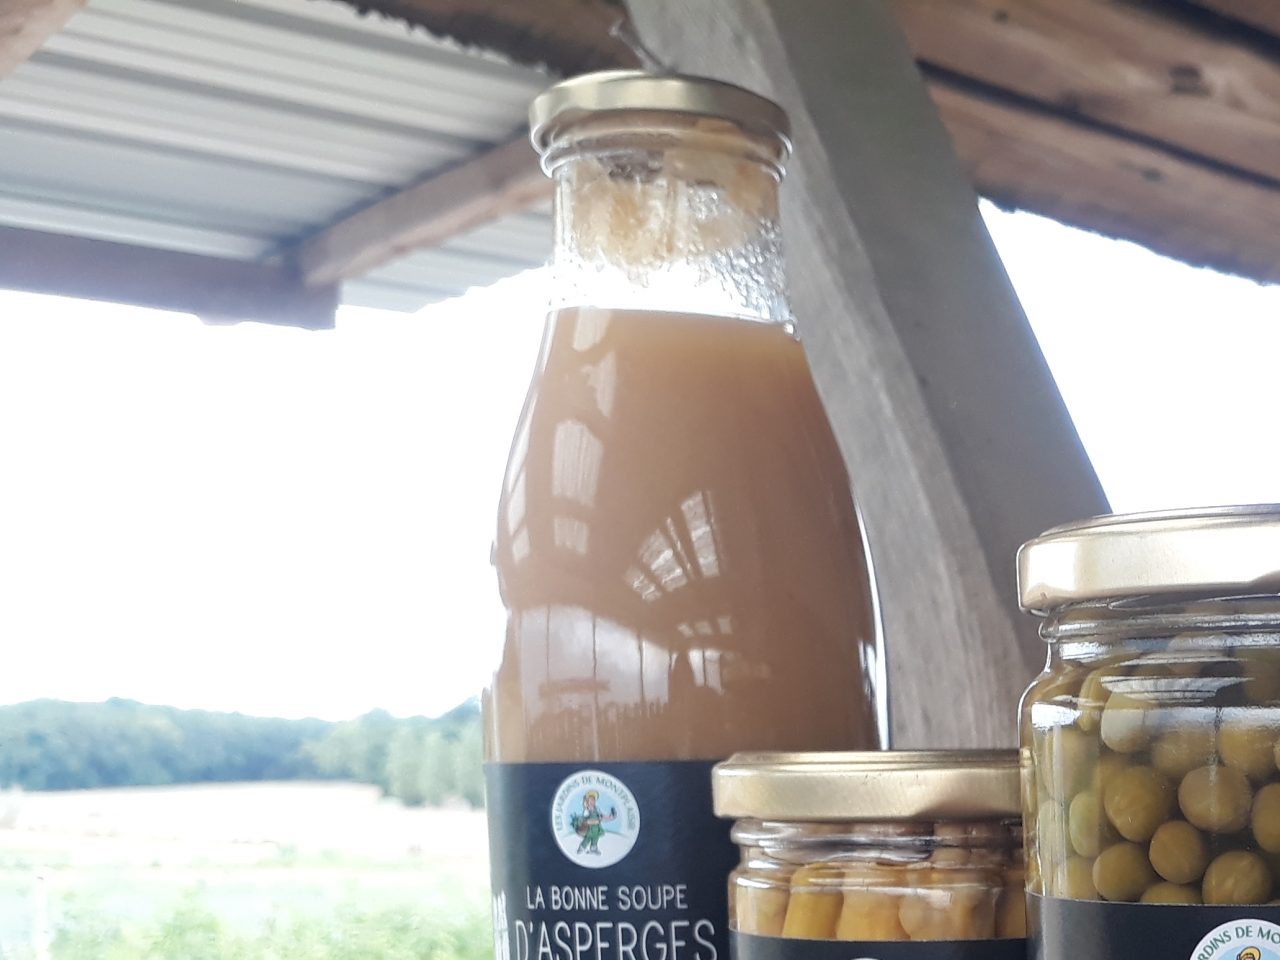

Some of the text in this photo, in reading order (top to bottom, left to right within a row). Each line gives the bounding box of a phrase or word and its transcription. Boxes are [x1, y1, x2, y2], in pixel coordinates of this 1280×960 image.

[527, 884, 688, 911] LA BONNE SOUPE
[1235, 925, 1253, 939] DE
